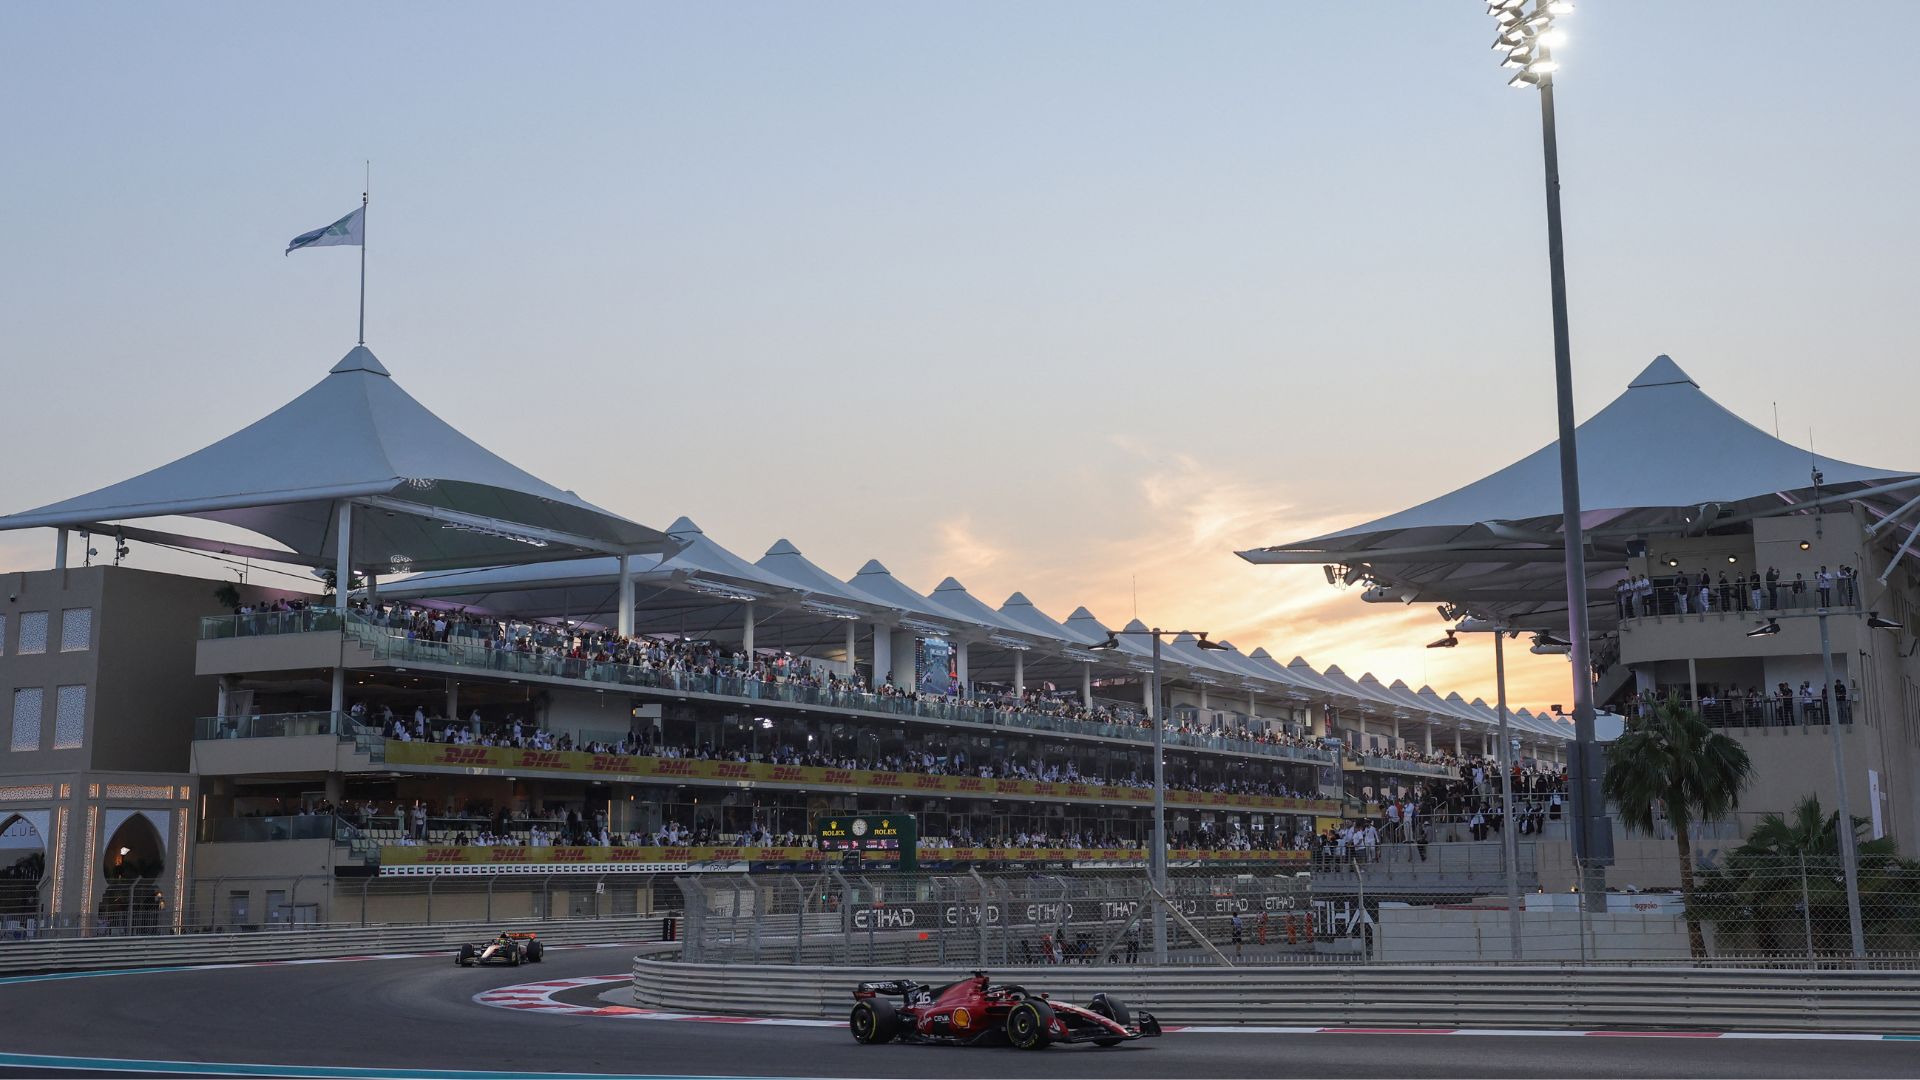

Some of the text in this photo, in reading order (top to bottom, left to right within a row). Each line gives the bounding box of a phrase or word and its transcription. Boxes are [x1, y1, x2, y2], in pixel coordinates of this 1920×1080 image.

[440, 747, 491, 766] DHL
[518, 751, 564, 768] DHL
[590, 755, 635, 772] DHL
[656, 759, 694, 775] DHL
[716, 763, 752, 778] DHL
[771, 767, 804, 781] DHL
[424, 848, 464, 862] DHL
[491, 848, 527, 862] DHL
[552, 848, 588, 861] DHL
[609, 848, 643, 861] DHL
[663, 848, 693, 861] DHL
[712, 848, 742, 861] DHL
[758, 849, 786, 860] DHL
[946, 905, 1000, 923] EHD
[1099, 902, 1138, 918] TIHA
[1265, 896, 1295, 909] ETIHAD
[1311, 901, 1376, 935] TIHA
[916, 991, 931, 1004] 16
